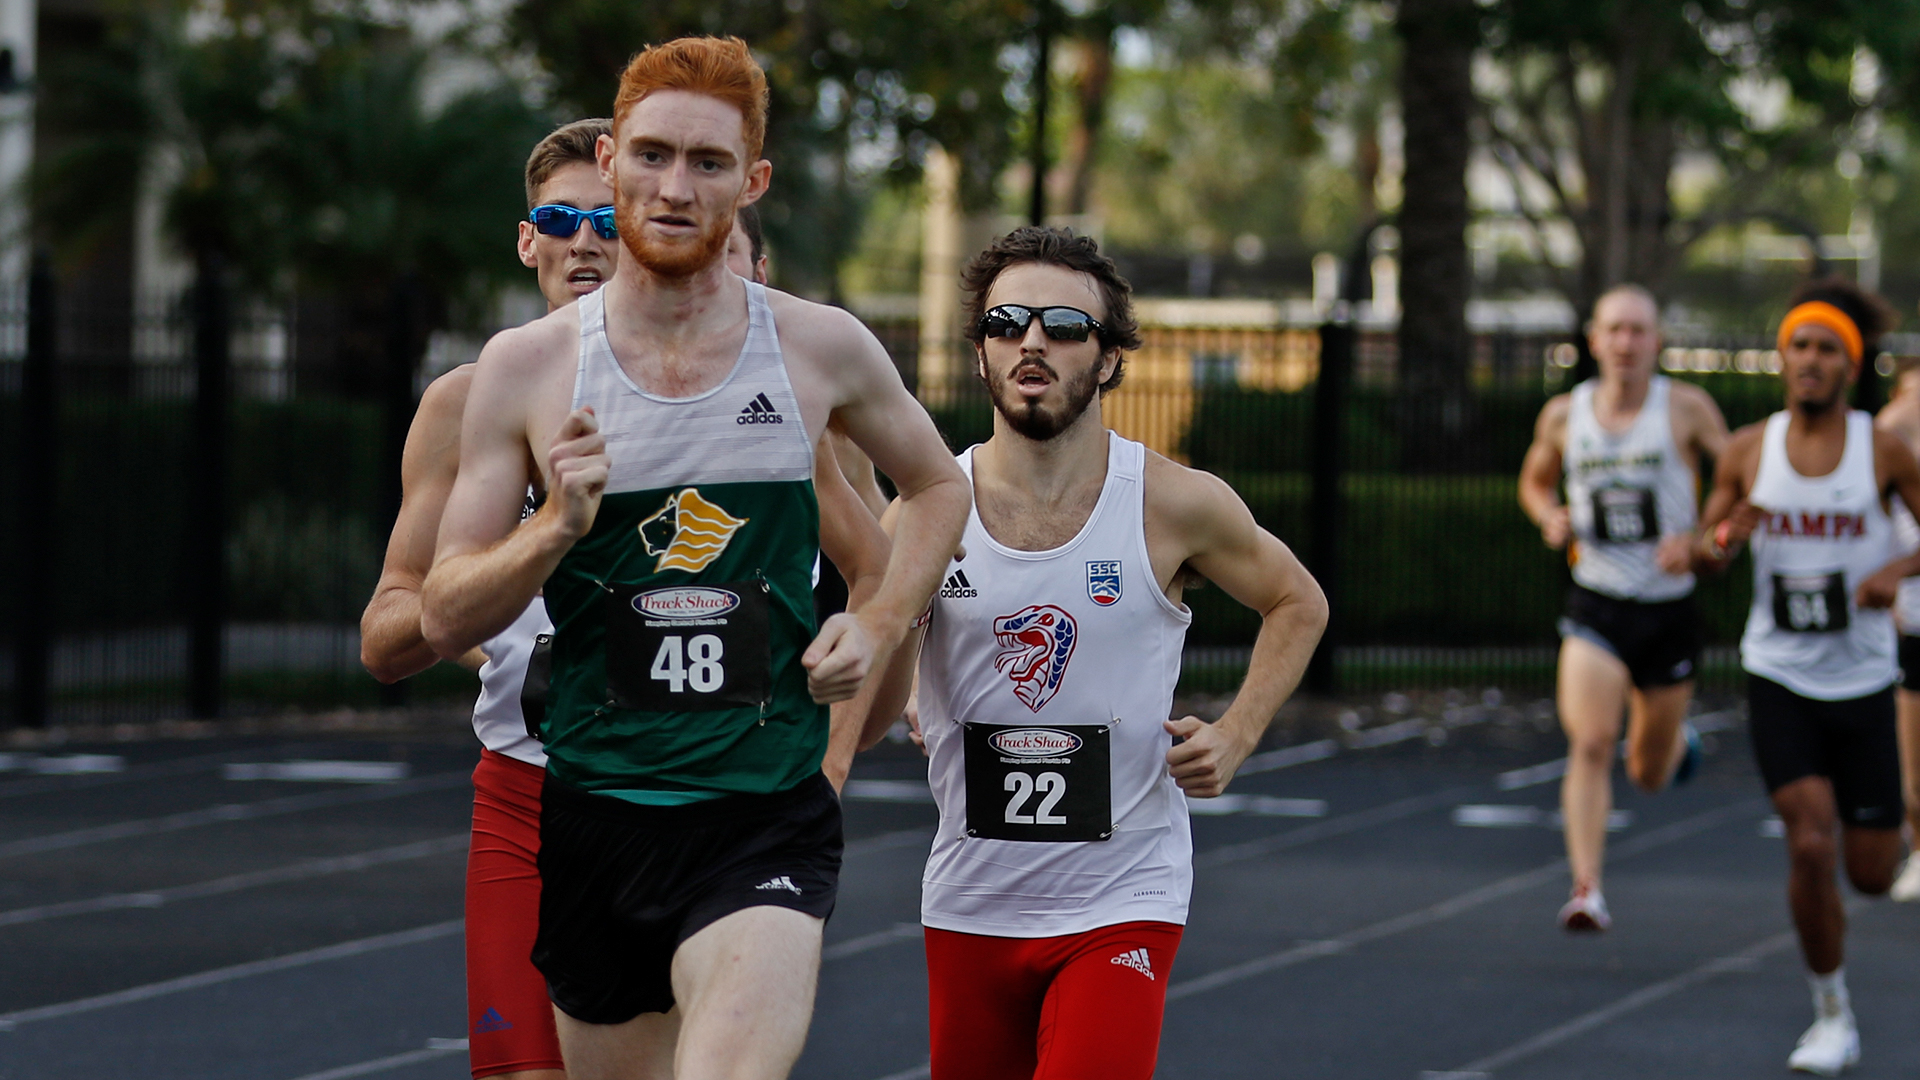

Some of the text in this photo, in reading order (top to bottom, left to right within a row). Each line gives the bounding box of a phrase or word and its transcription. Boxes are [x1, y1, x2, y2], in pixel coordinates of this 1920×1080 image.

[737, 412, 783, 425] adidas
[1761, 511, 1866, 538] TAMPA
[1090, 563, 1118, 575] SSC
[940, 586, 977, 599] adidas
[641, 593, 733, 610] Track Shack
[650, 633, 725, 693] 48
[996, 734, 1076, 749] Track Shack
[1004, 771, 1067, 824] 22
[1110, 956, 1155, 981] adidas
